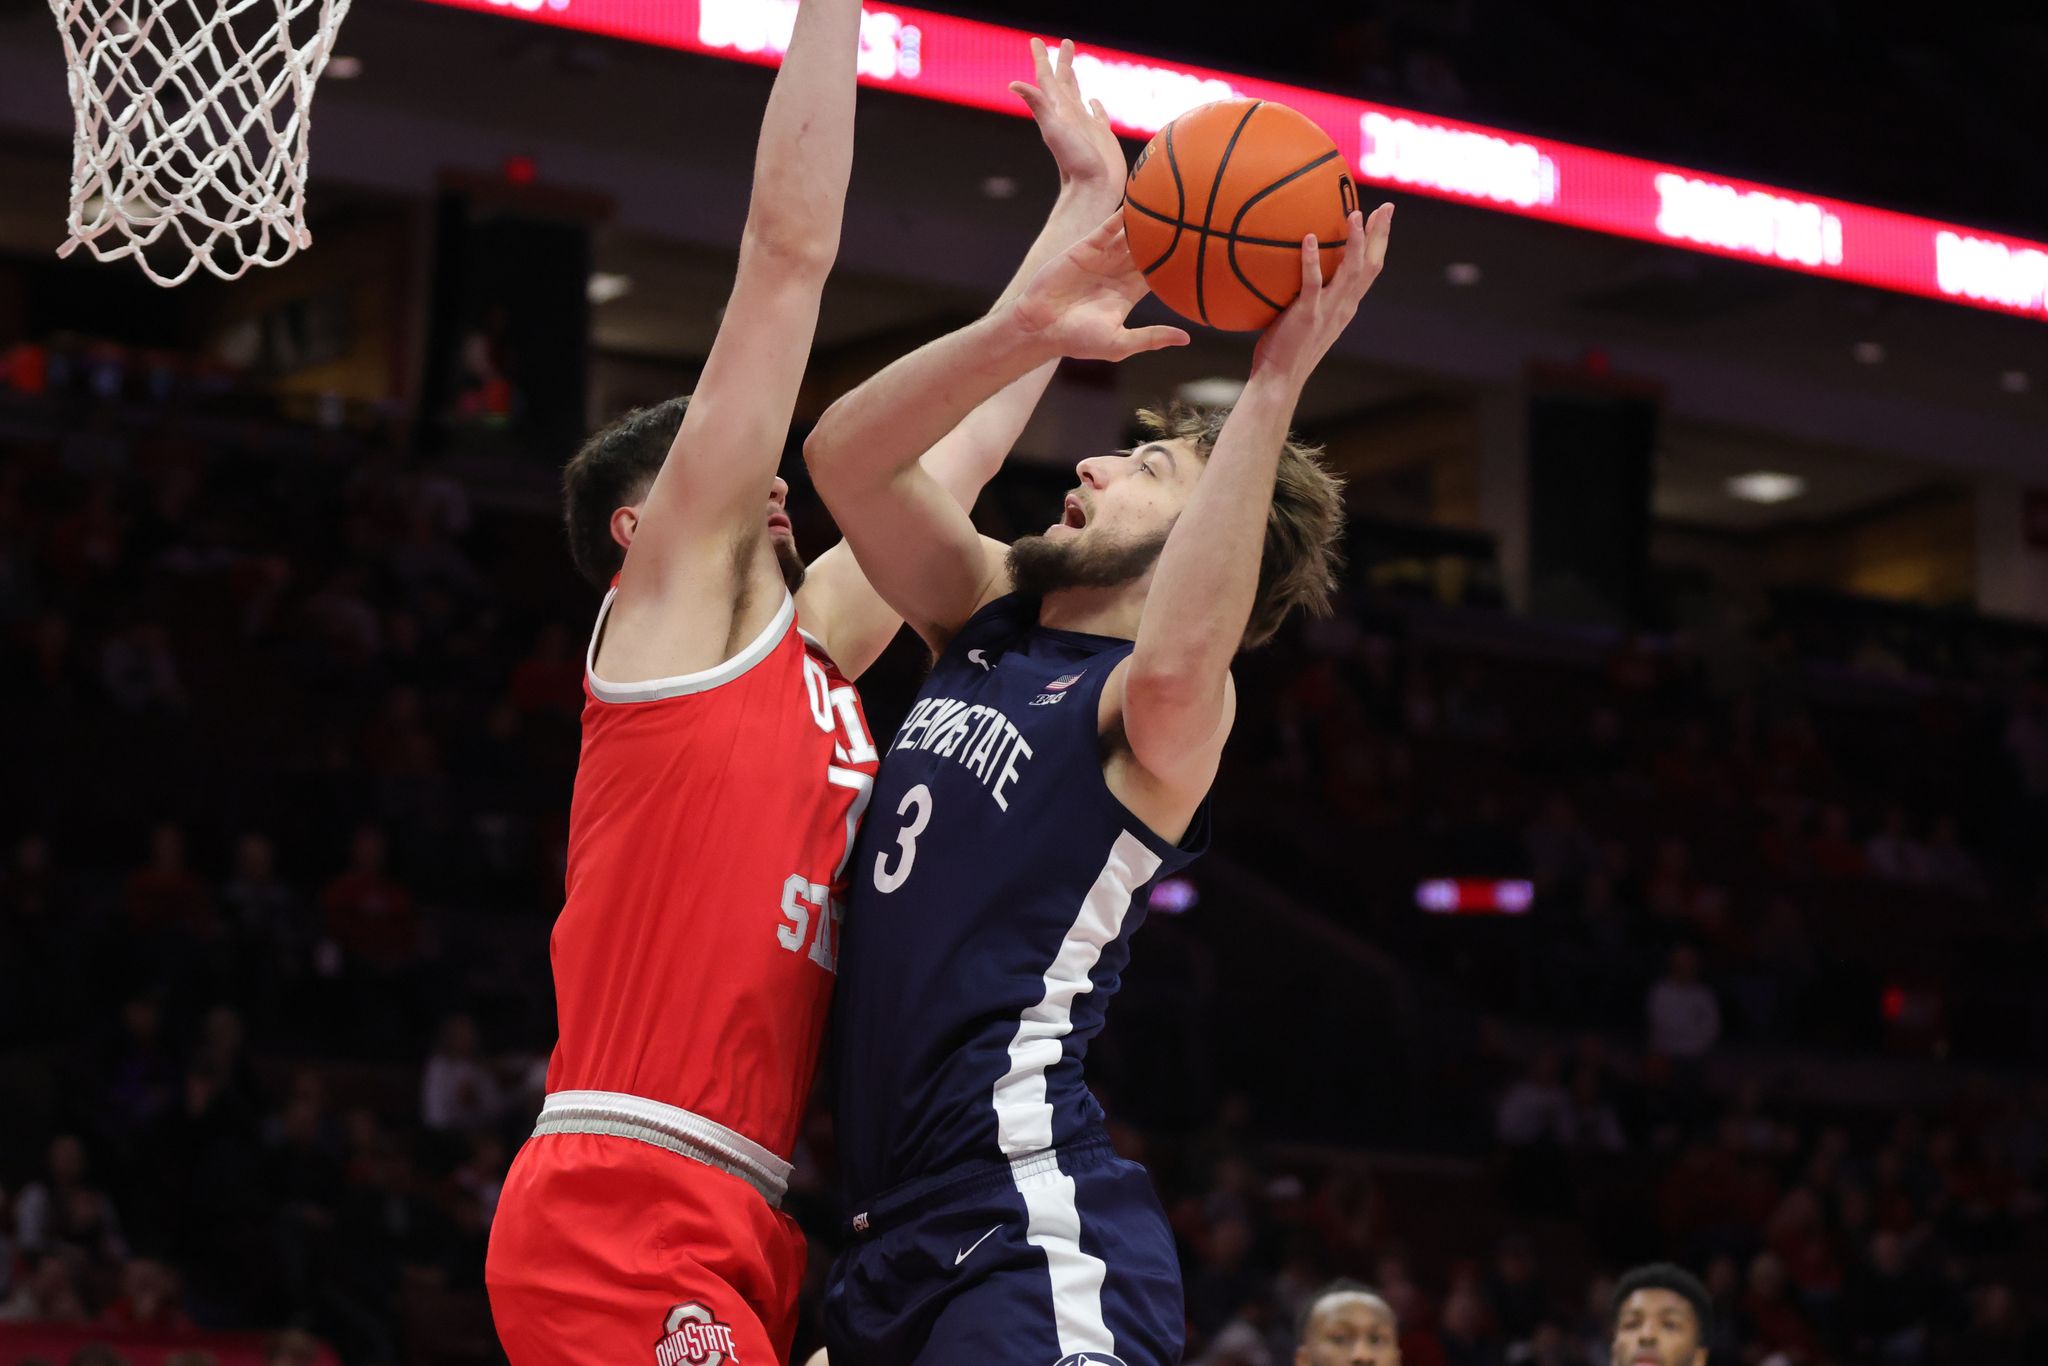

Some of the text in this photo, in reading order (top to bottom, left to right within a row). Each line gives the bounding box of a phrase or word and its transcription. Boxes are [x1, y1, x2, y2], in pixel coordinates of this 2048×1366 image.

[942, 704, 1033, 813] STATE
[873, 783, 933, 894] 3
[655, 1322, 740, 1366] OHIO STATE
